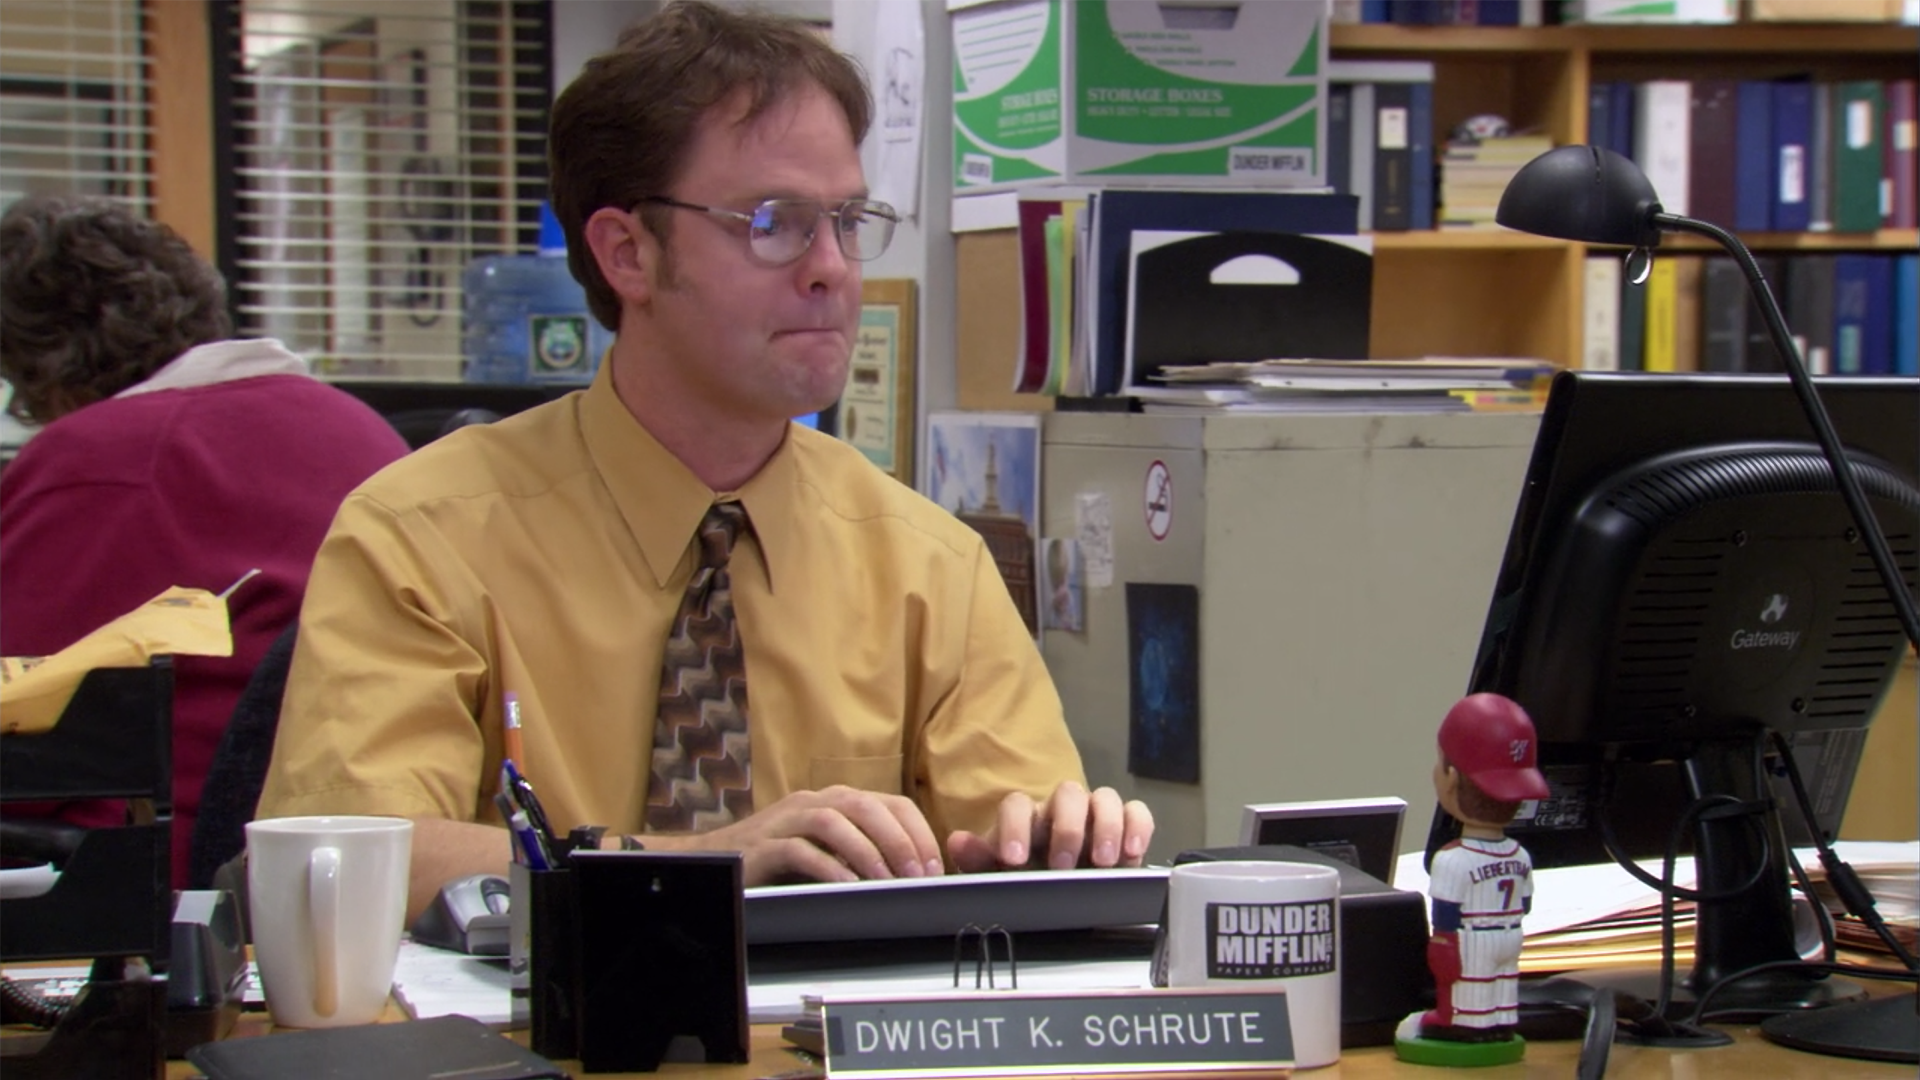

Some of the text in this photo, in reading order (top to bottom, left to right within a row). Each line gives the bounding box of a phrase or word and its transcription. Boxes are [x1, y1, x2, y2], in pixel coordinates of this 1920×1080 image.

[1087, 87, 1224, 103] STORAGE BOXES
[1233, 154, 1305, 171] DUNDER MIFFLIN
[1730, 628, 1801, 650] Gateway
[1498, 878, 1515, 910] 7
[1217, 903, 1331, 935] DUNDER
[1217, 966, 1262, 976] PAPER
[856, 1012, 1264, 1053] DWIGHT K. SCHRUTE
